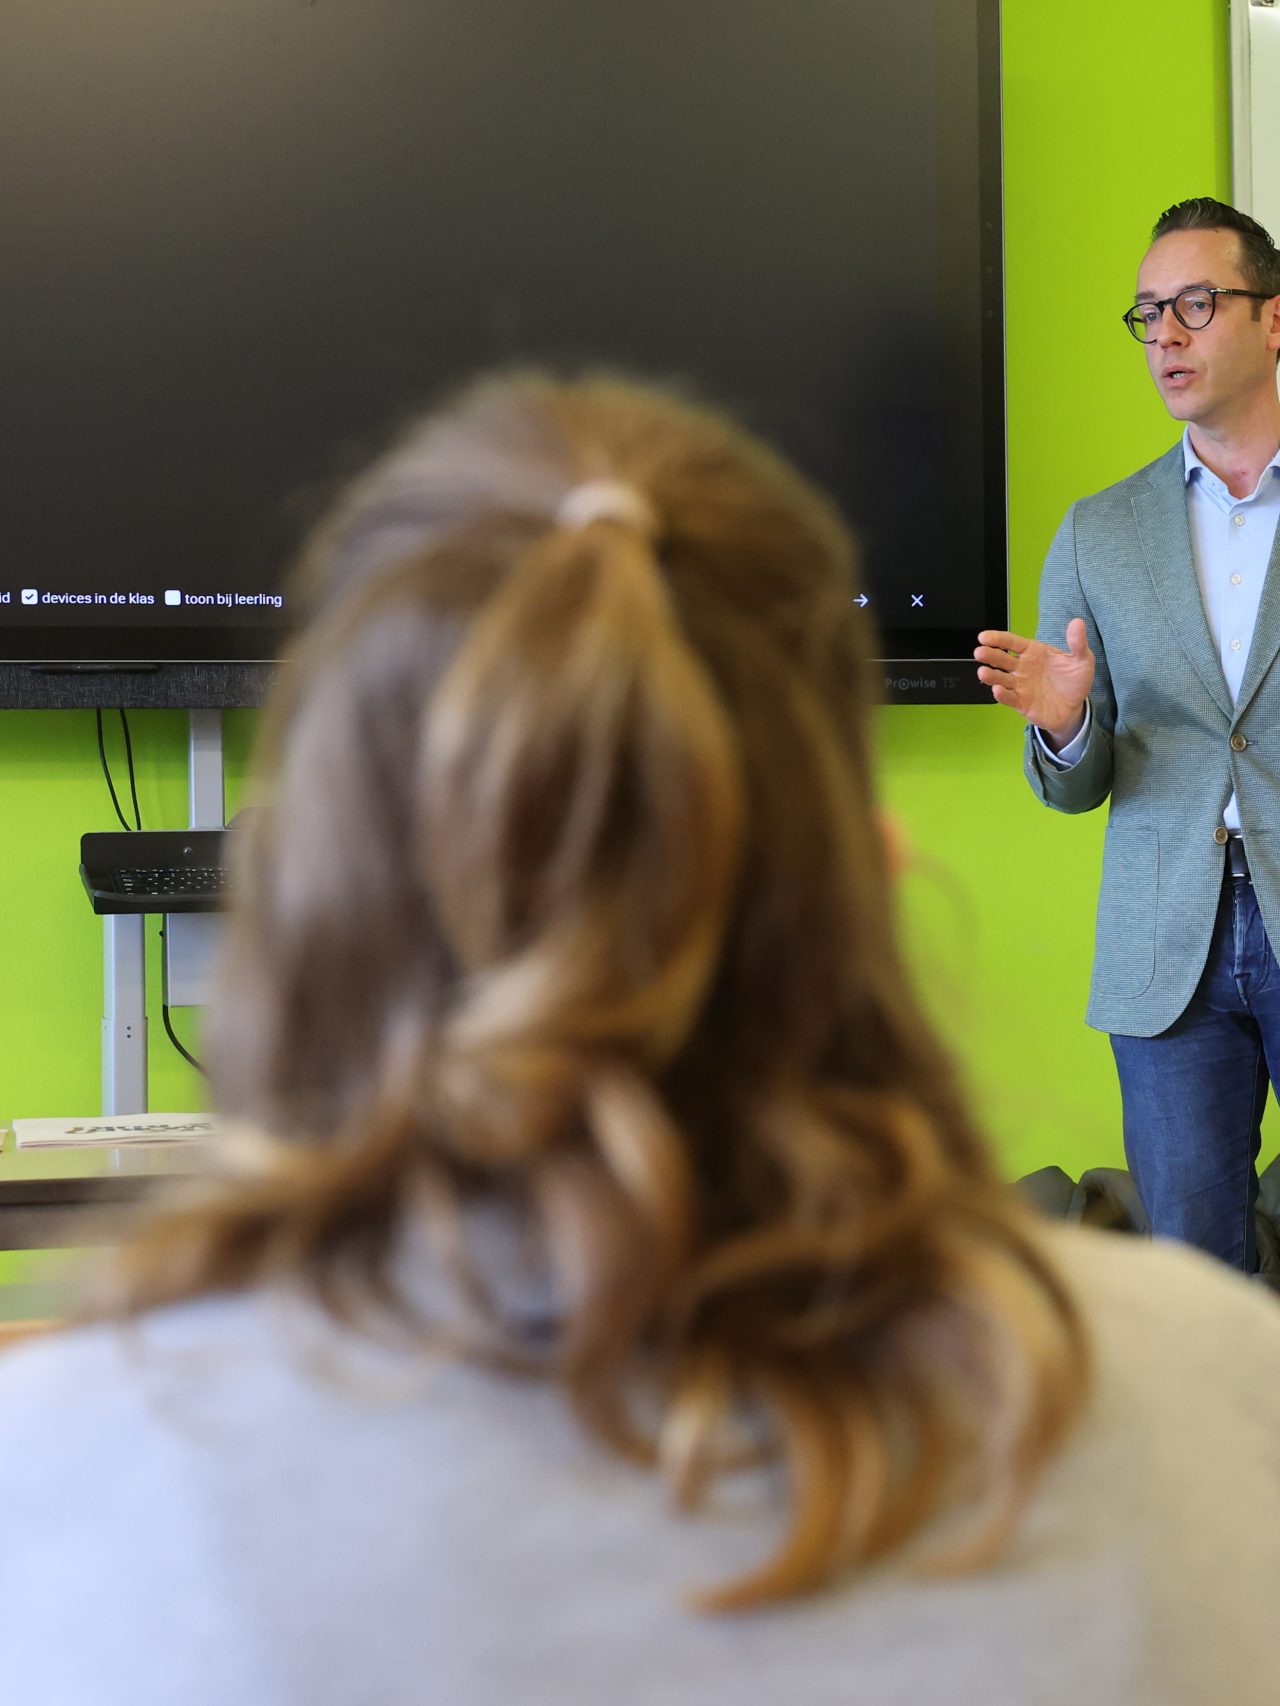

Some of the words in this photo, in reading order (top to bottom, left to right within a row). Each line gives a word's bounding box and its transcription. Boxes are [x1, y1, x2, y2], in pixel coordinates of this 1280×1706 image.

[41, 592, 92, 604] devices
[94, 592, 106, 604] in
[109, 593, 126, 604] de
[129, 593, 155, 604] klas
[185, 594, 215, 605] toon
[217, 593, 232, 607] bij
[235, 593, 283, 607] leerling
[885, 677, 936, 690] Prowise
